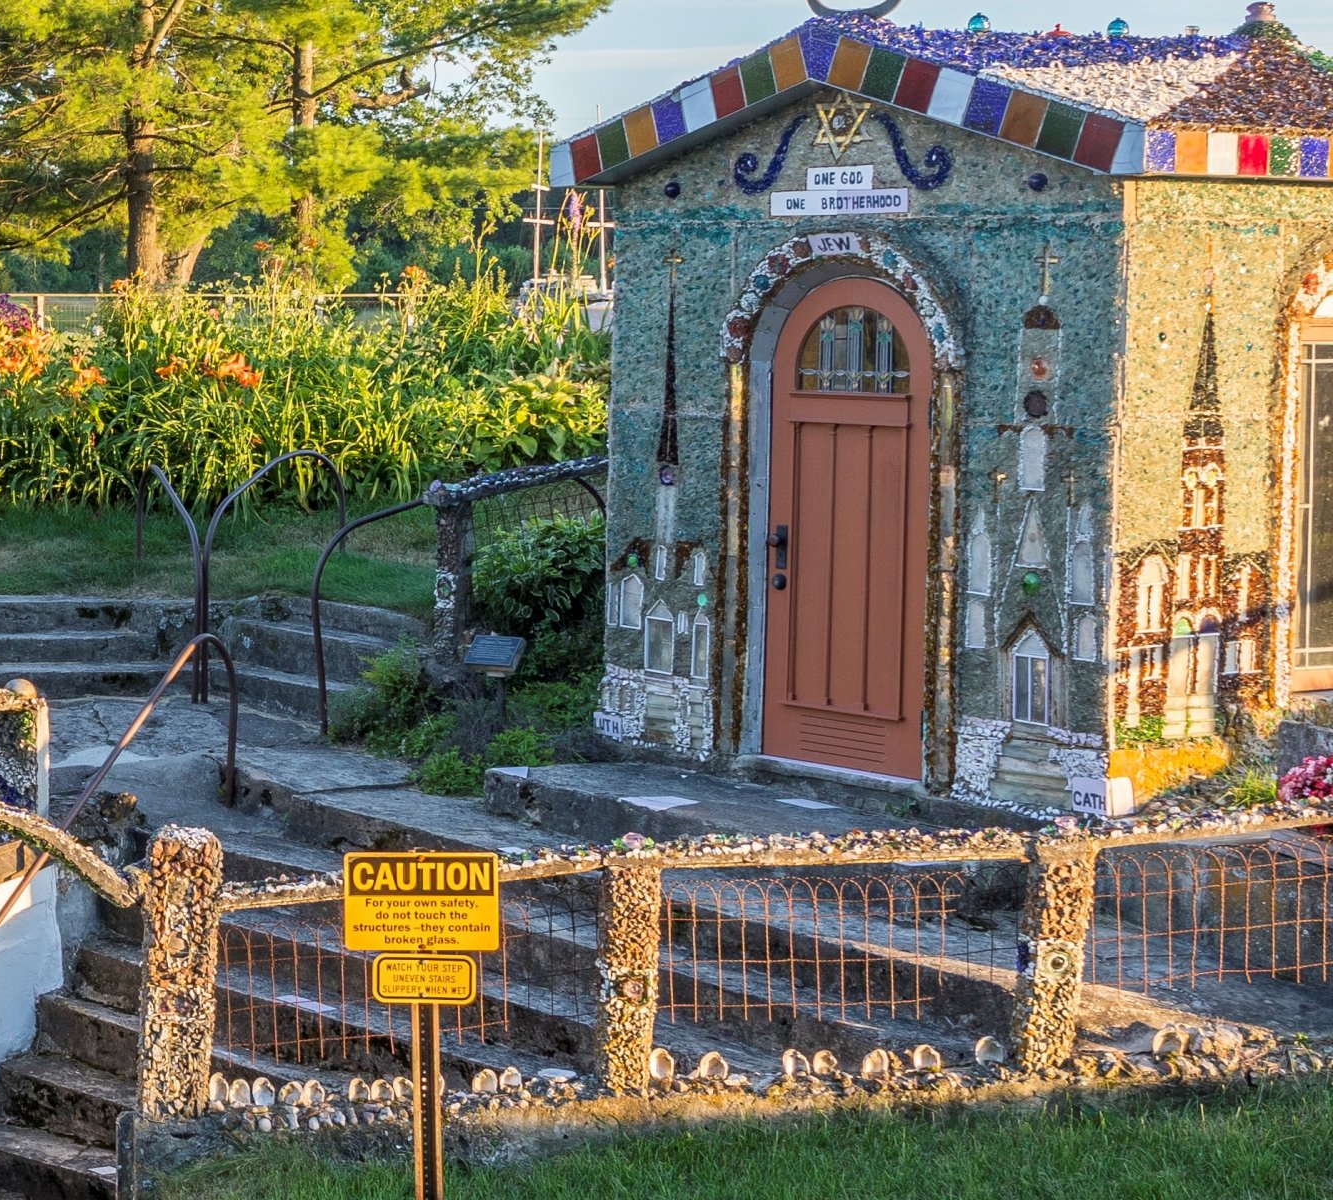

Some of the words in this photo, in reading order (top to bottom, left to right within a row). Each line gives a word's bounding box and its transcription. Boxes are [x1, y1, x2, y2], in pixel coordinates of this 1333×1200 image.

[814, 172, 836, 186] ONE
[840, 171, 863, 185] GOD
[786, 198, 806, 210] ONE
[821, 194, 901, 210] BROTHERHOOD
[817, 236, 851, 252] JEW
[1073, 791, 1107, 812] CATH
[352, 861, 491, 892] CAUTION
[365, 898, 384, 908] For
[386, 900, 411, 910] your
[414, 900, 437, 908] own
[440, 898, 479, 910] safety,
[375, 911, 390, 920] do
[393, 911, 411, 920] not
[414, 911, 446, 920] touch
[450, 911, 468, 920] the
[353, 923, 411, 932] structures
[448, 922, 491, 932] contain
[384, 935, 424, 945] broken
[426, 935, 460, 947] glass.
[386, 963, 412, 972] WATCH
[415, 963, 439, 972] YOUR
[442, 964, 463, 973] STEP
[393, 974, 426, 983] UNEVEN
[428, 974, 456, 983] STAIRS
[382, 985, 422, 994] SLIPPERY
[425, 985, 448, 994] WHEN
[450, 986, 467, 995] WET
